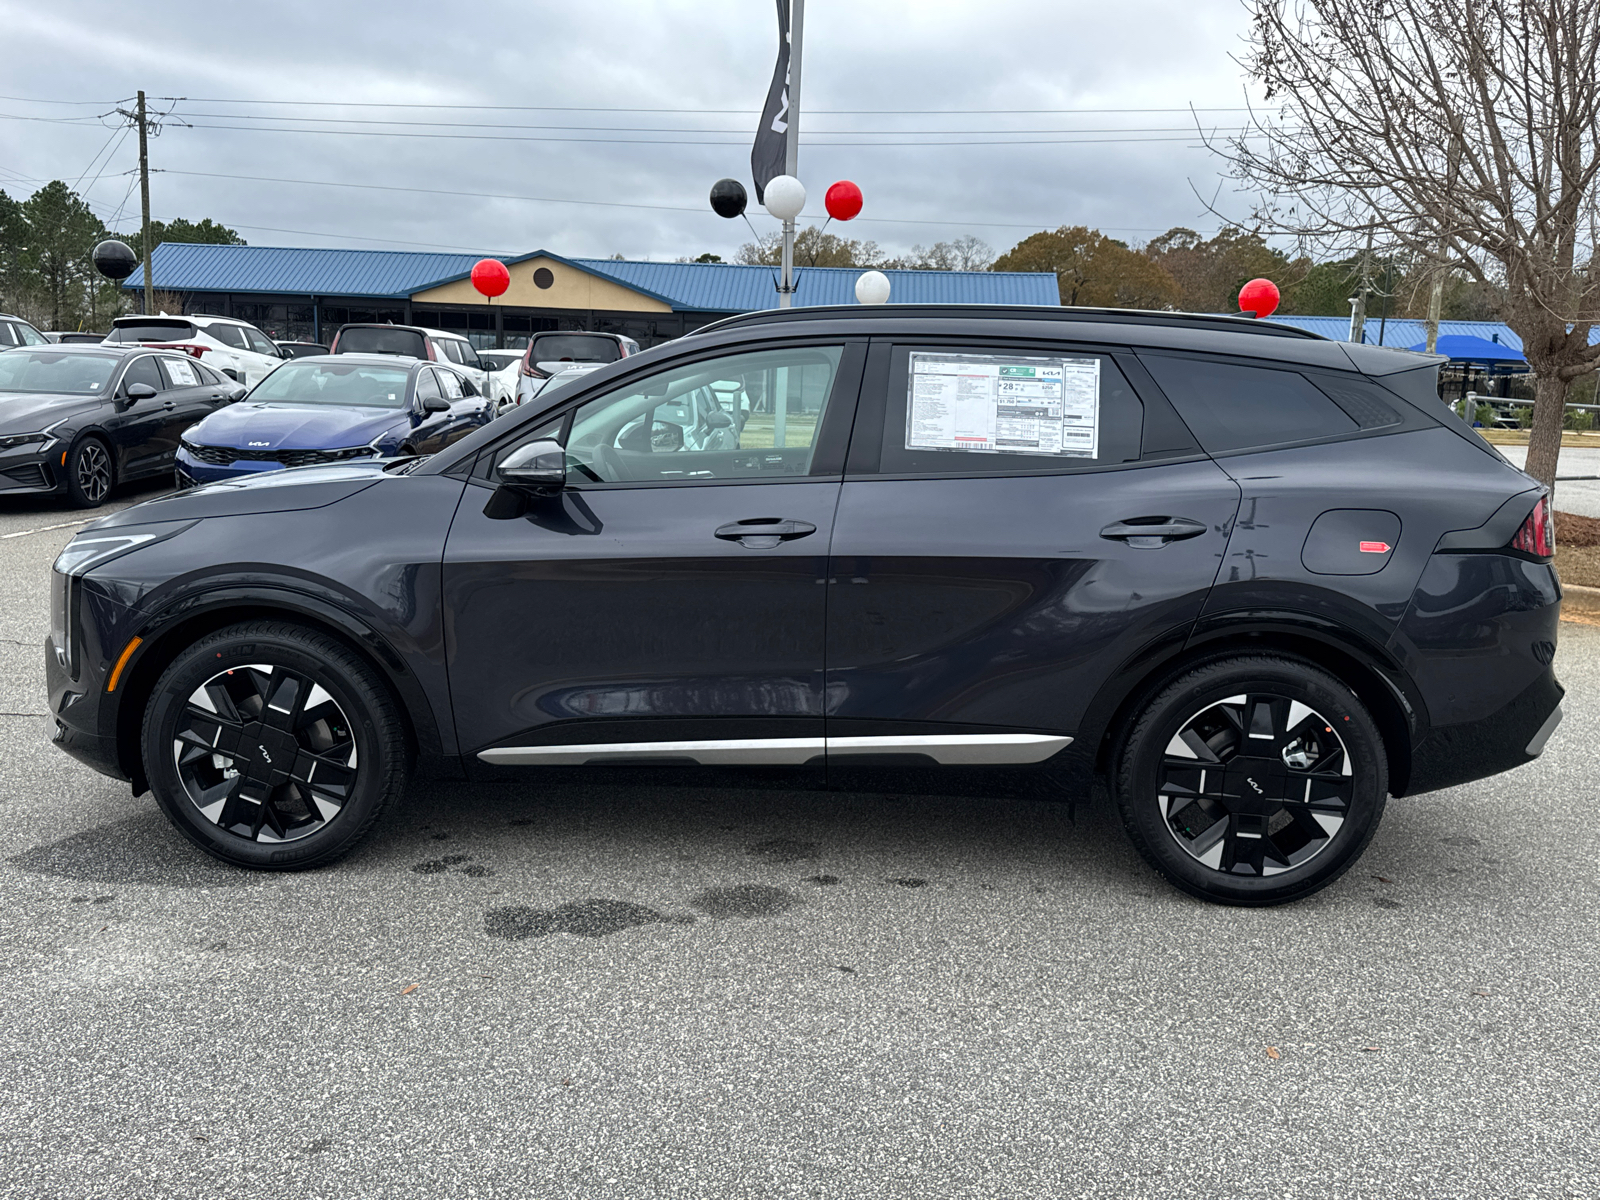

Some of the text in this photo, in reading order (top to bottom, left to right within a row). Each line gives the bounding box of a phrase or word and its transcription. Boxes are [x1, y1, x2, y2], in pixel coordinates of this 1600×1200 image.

[1003, 382, 1014, 390] 28
[258, 744, 272, 763] KIA
[1246, 777, 1264, 794] KIA
